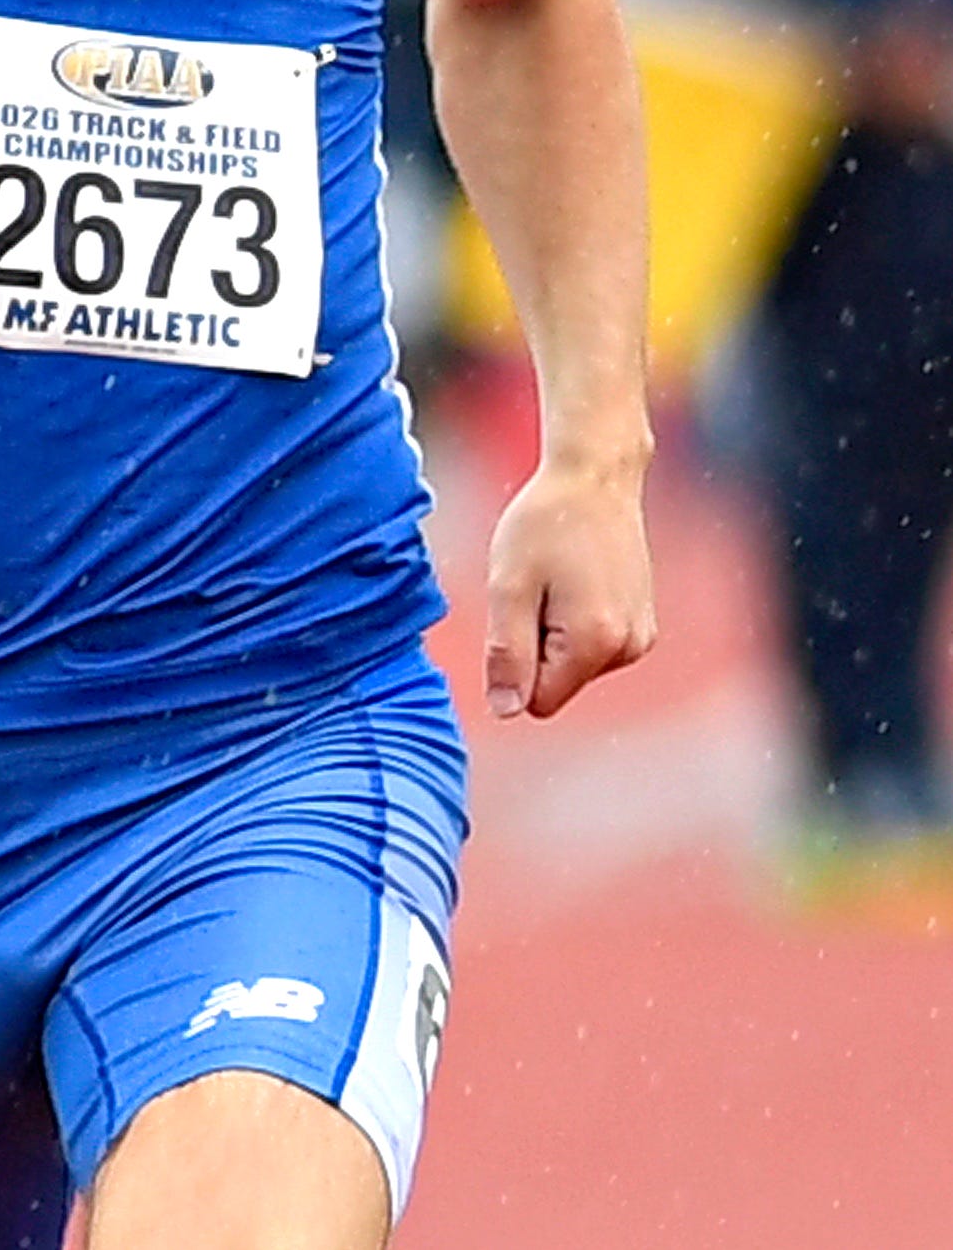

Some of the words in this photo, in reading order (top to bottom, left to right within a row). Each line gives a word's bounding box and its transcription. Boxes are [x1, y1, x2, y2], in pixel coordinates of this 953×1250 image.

[72, 46, 205, 100] PIAA
[68, 109, 167, 143] TRACK
[175, 124, 194, 145] &
[205, 124, 282, 153] FIELD
[3, 132, 260, 179] CHAMPIONSHIPS
[63, 304, 241, 348] ATHLETIC
